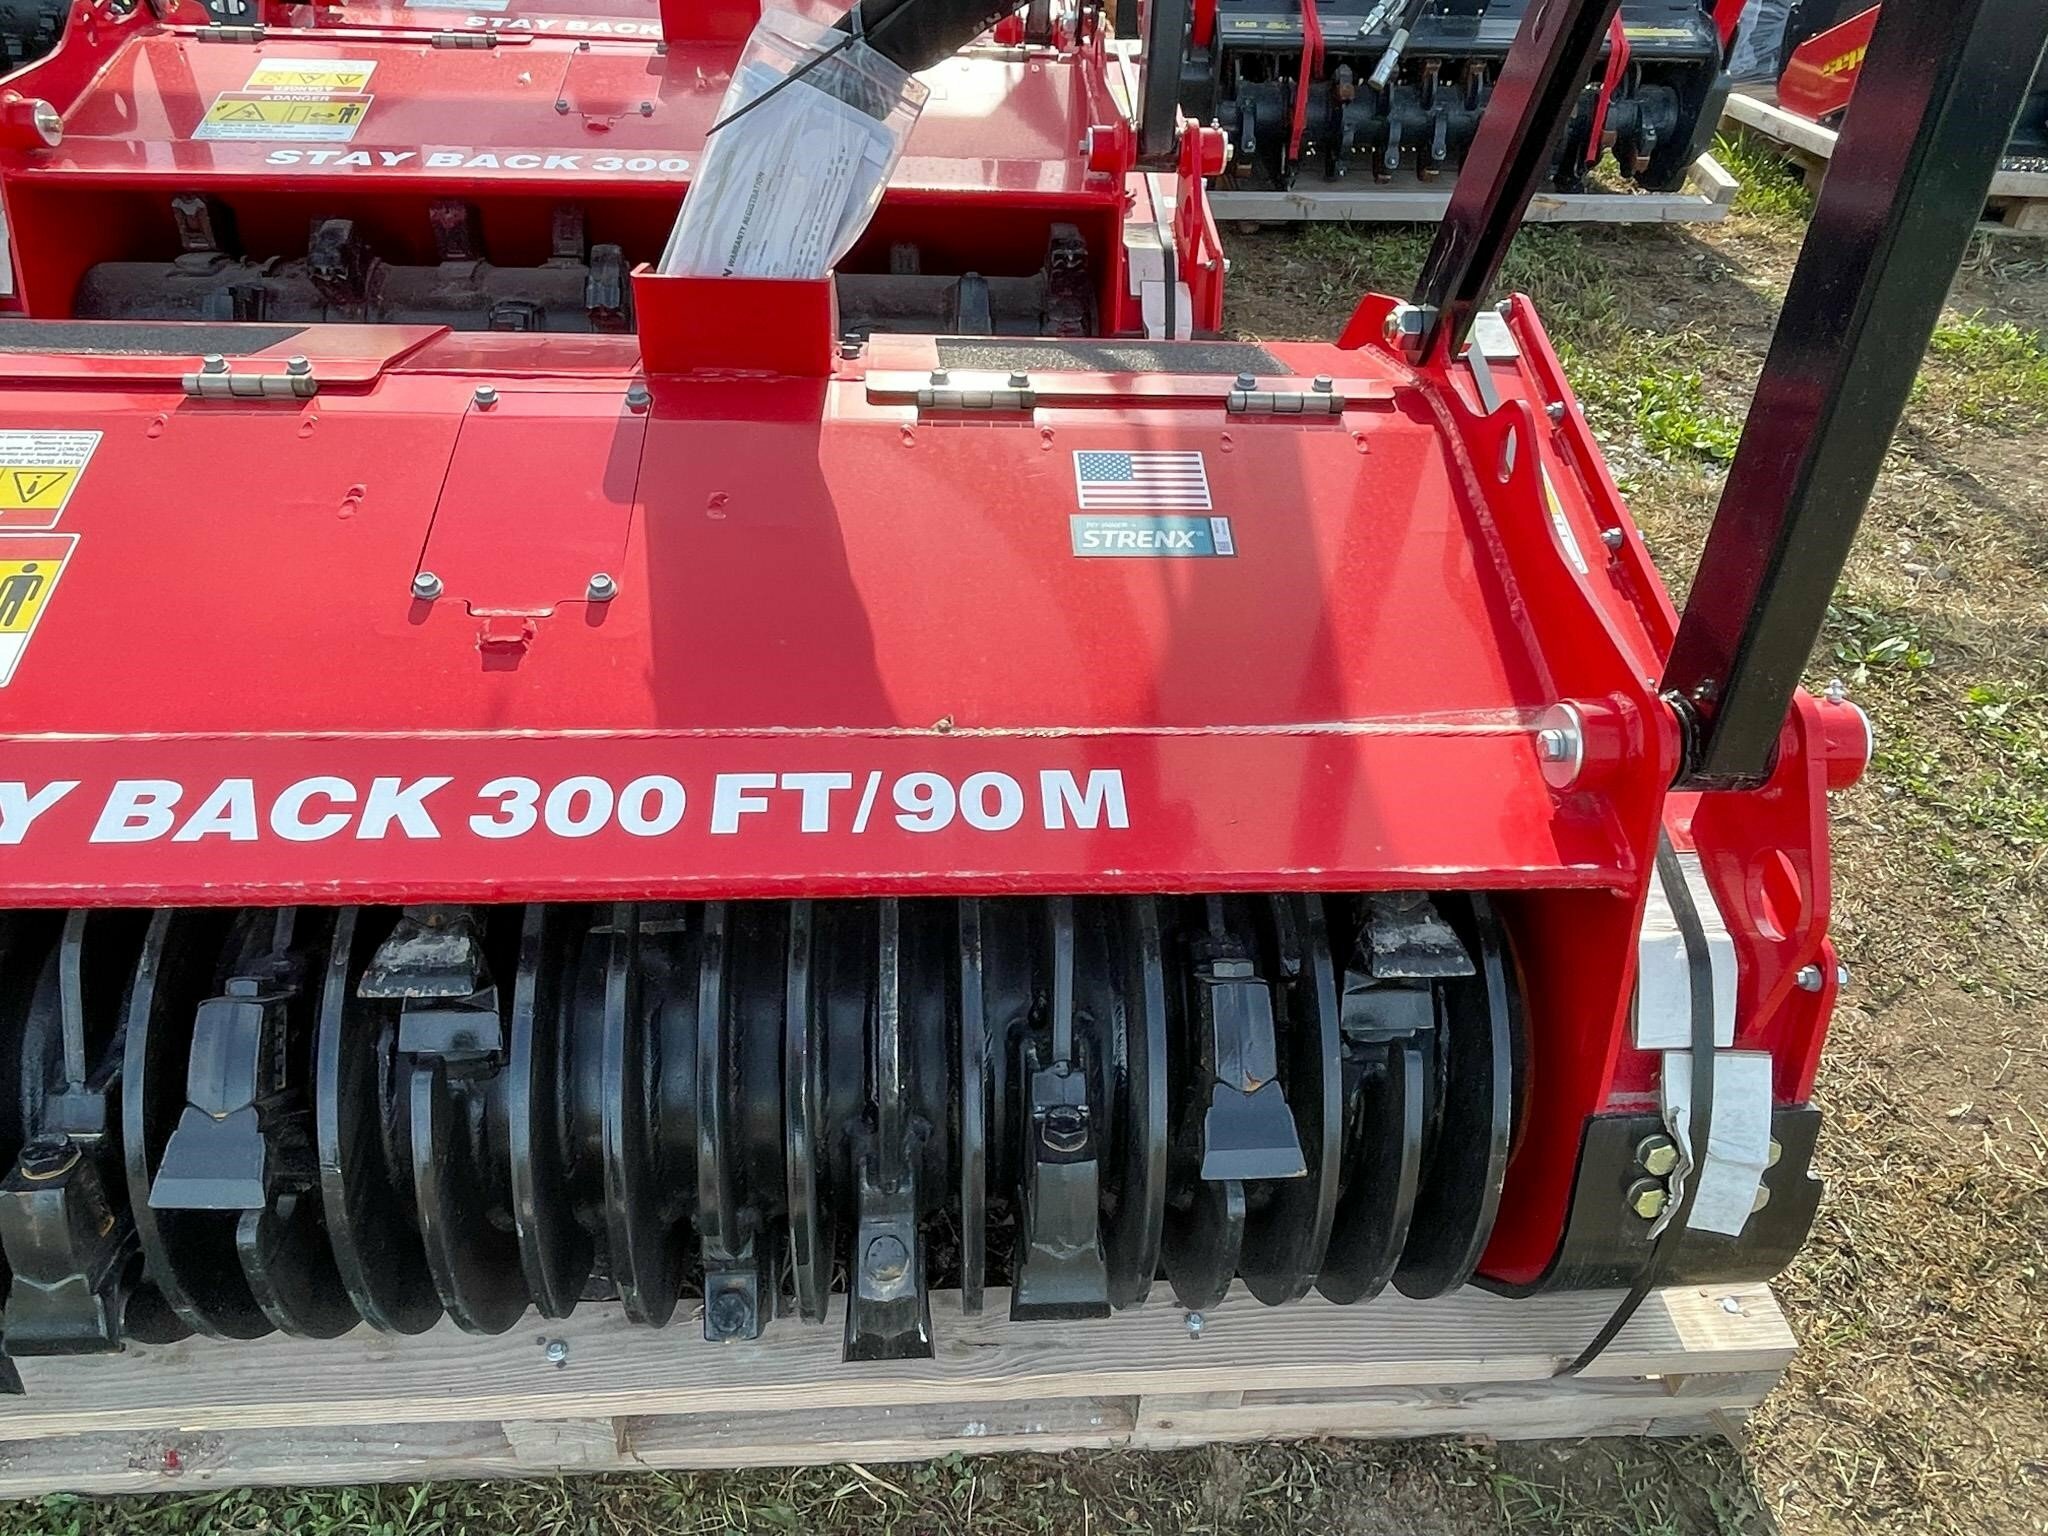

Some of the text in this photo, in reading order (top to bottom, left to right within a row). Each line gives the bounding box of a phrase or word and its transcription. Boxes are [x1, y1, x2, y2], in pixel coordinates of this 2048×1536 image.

[464, 16, 662, 35] STAY BACK
[265, 150, 690, 173] STAY BACK 300
[727, 225, 746, 268] WARRANTY
[1082, 530, 1196, 549] STRENX
[88, 776, 454, 843] BACK
[469, 774, 687, 839] 300
[709, 770, 1025, 835] FT/90
[1038, 769, 1131, 830] M
